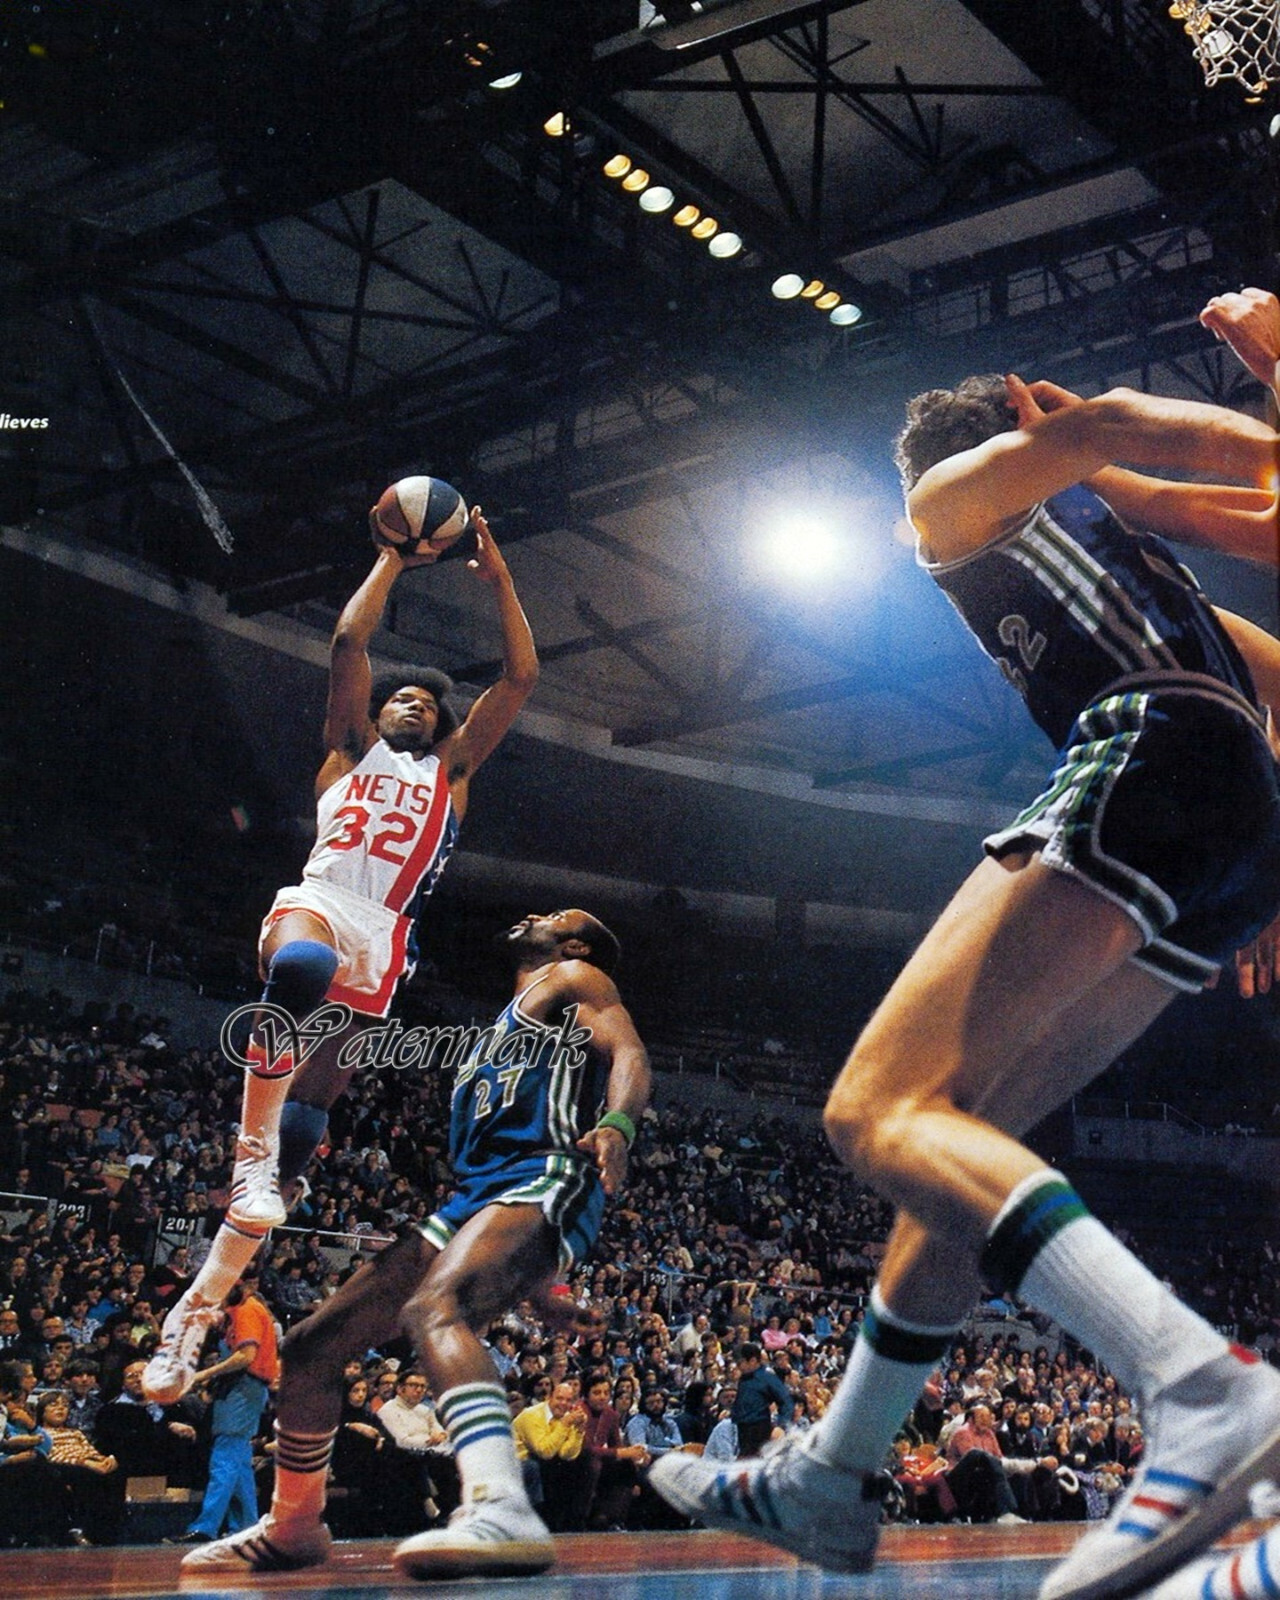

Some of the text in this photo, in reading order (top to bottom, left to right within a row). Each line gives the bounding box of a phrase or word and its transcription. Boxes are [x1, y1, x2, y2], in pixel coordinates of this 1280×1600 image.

[345, 774, 432, 816] NETS
[327, 805, 418, 867] 32
[474, 1068, 526, 1119] 27
